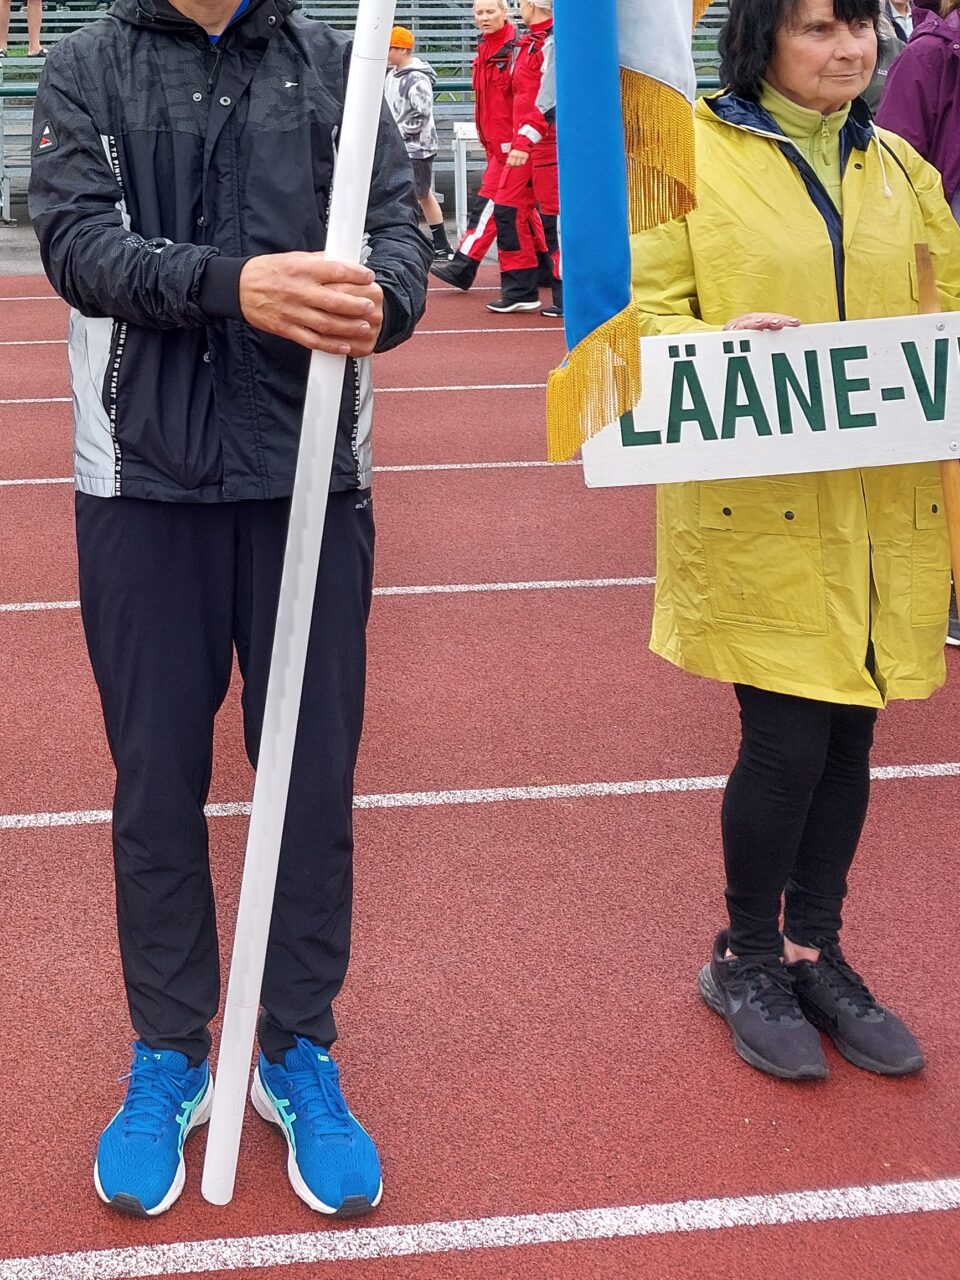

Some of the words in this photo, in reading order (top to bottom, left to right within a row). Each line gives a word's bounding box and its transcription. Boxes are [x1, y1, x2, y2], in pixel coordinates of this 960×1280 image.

[118, 322, 128, 345] INISH
[113, 357, 121, 369] TO
[110, 371, 118, 399] START
[620, 337, 960, 447] LÄÄNE-V
[109, 404, 117, 420] THE
[115, 461, 122, 471] TO
